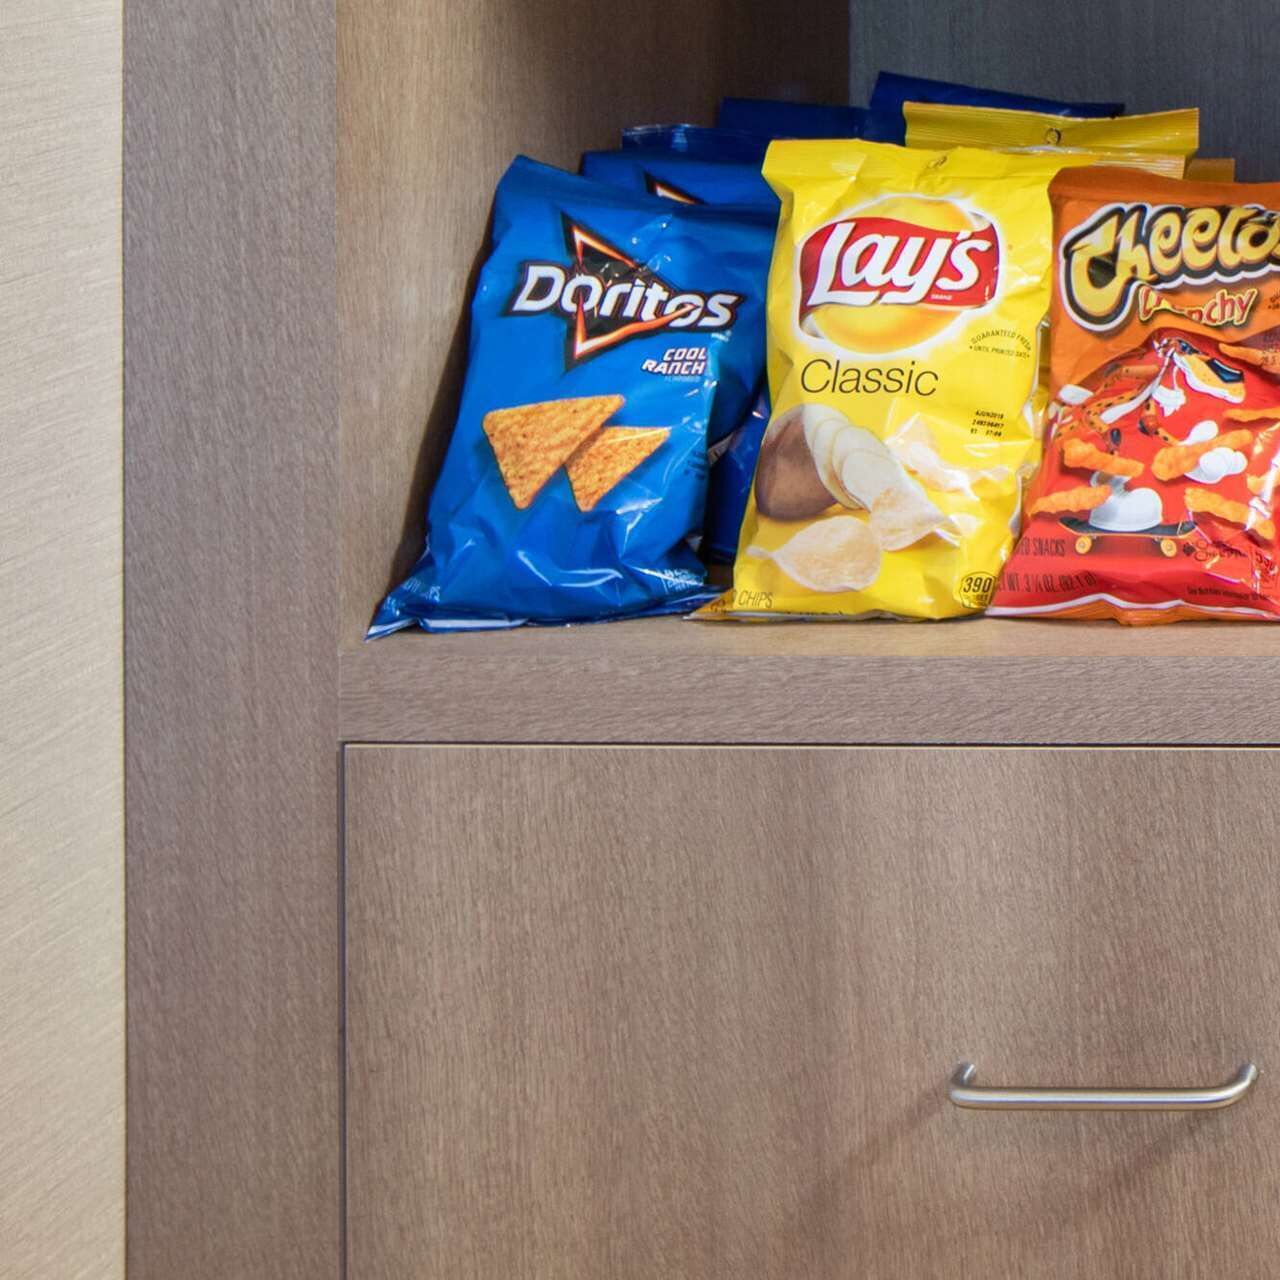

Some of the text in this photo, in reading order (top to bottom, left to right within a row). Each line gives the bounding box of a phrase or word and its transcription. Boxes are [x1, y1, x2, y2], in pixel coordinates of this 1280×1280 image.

[806, 222, 994, 307] Lay's
[511, 263, 738, 331] Doritos
[662, 347, 708, 362] COOL
[641, 359, 707, 376] RANCH
[800, 357, 940, 399] Classic
[962, 576, 992, 593] 390
[738, 588, 774, 609] CHIPS
